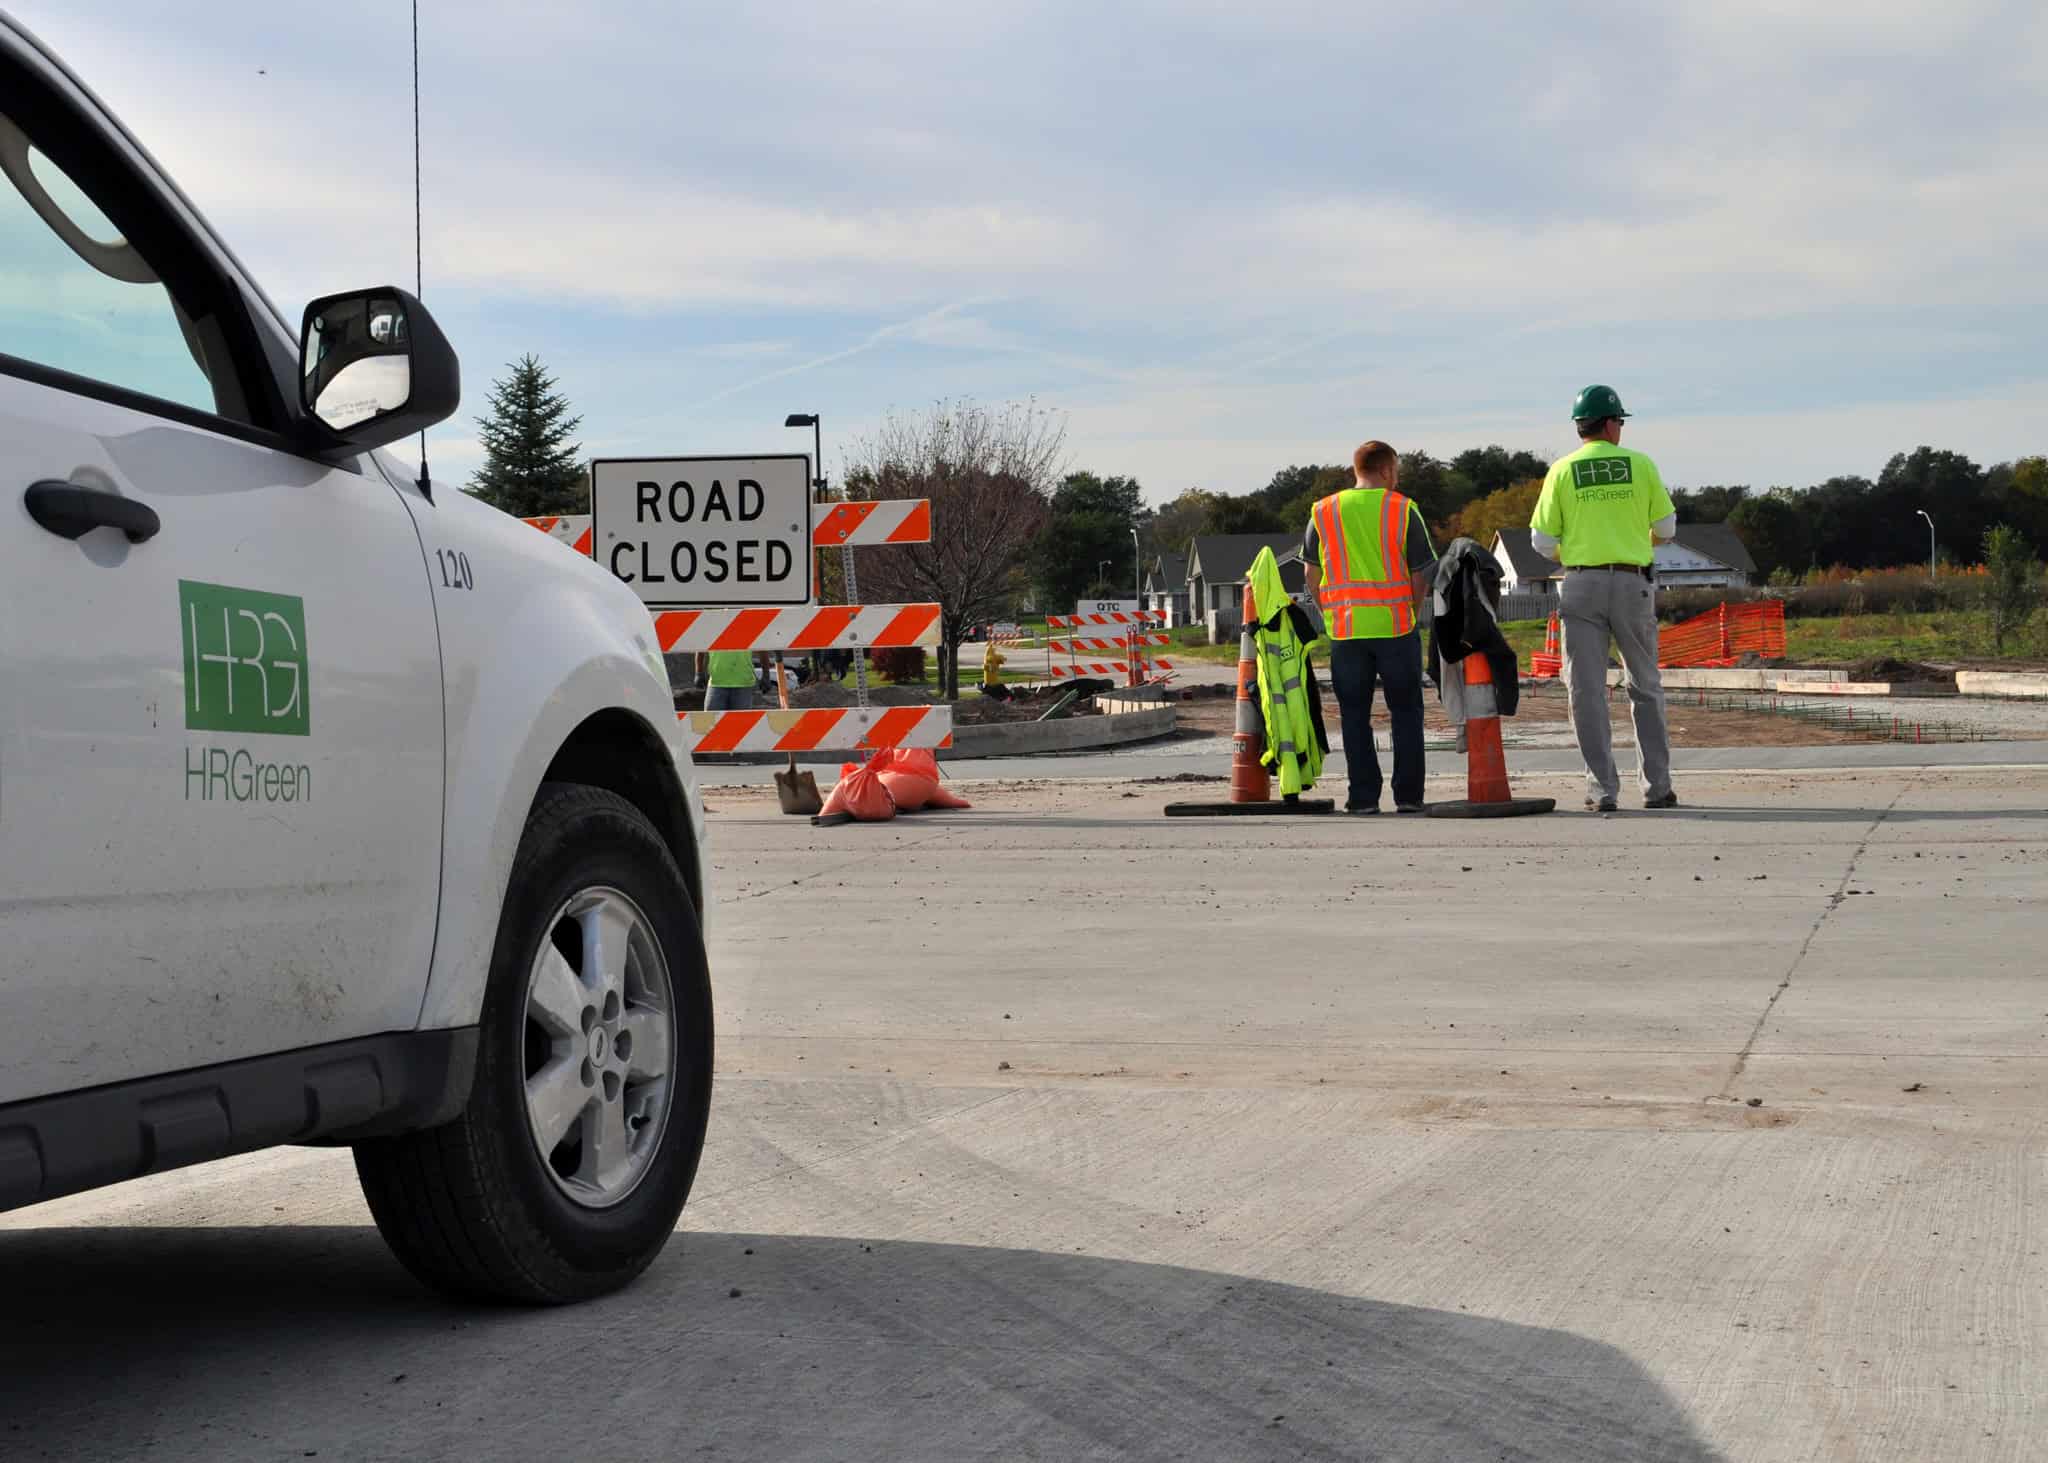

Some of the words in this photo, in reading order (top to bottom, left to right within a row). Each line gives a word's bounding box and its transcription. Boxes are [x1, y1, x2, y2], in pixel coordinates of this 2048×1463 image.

[636, 479, 765, 523] ROAD
[1576, 489, 1633, 503] HRGreen
[436, 548, 473, 591] 120
[610, 540, 793, 583] CLOSED
[1097, 602, 1120, 611] QTC
[190, 602, 301, 718] HRG
[185, 746, 311, 802] HRGreen
